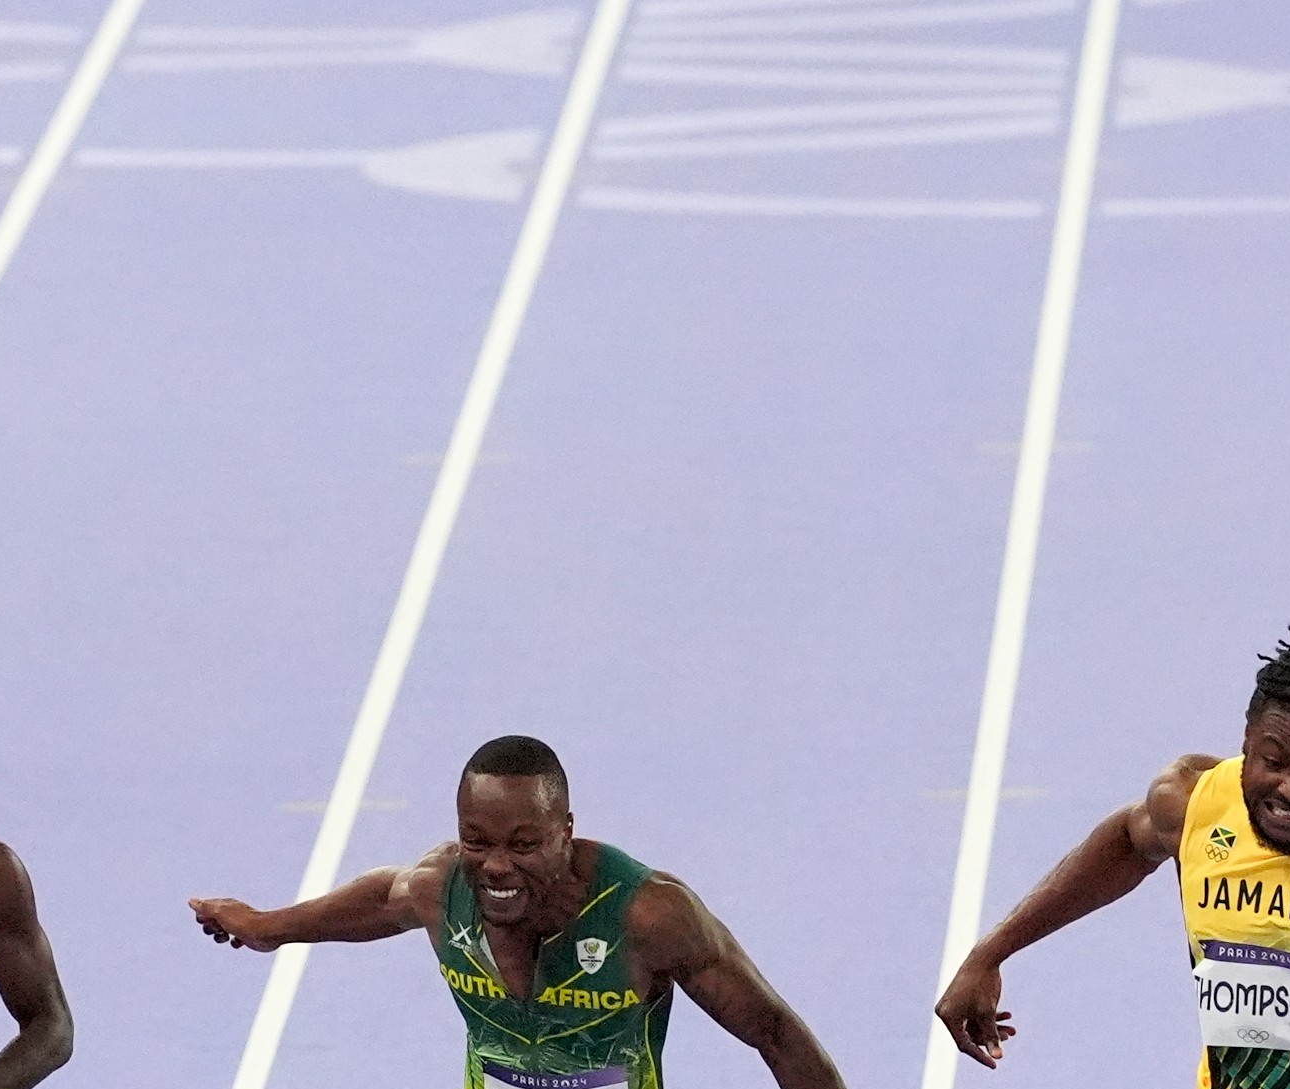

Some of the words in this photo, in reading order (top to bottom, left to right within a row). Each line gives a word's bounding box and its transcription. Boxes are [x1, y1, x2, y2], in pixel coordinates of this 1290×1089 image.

[1218, 946, 1256, 959] PARIS
[537, 986, 640, 1010] AFRICA
[511, 1074, 548, 1087] PARIS
[552, 1077, 587, 1088] 2024
